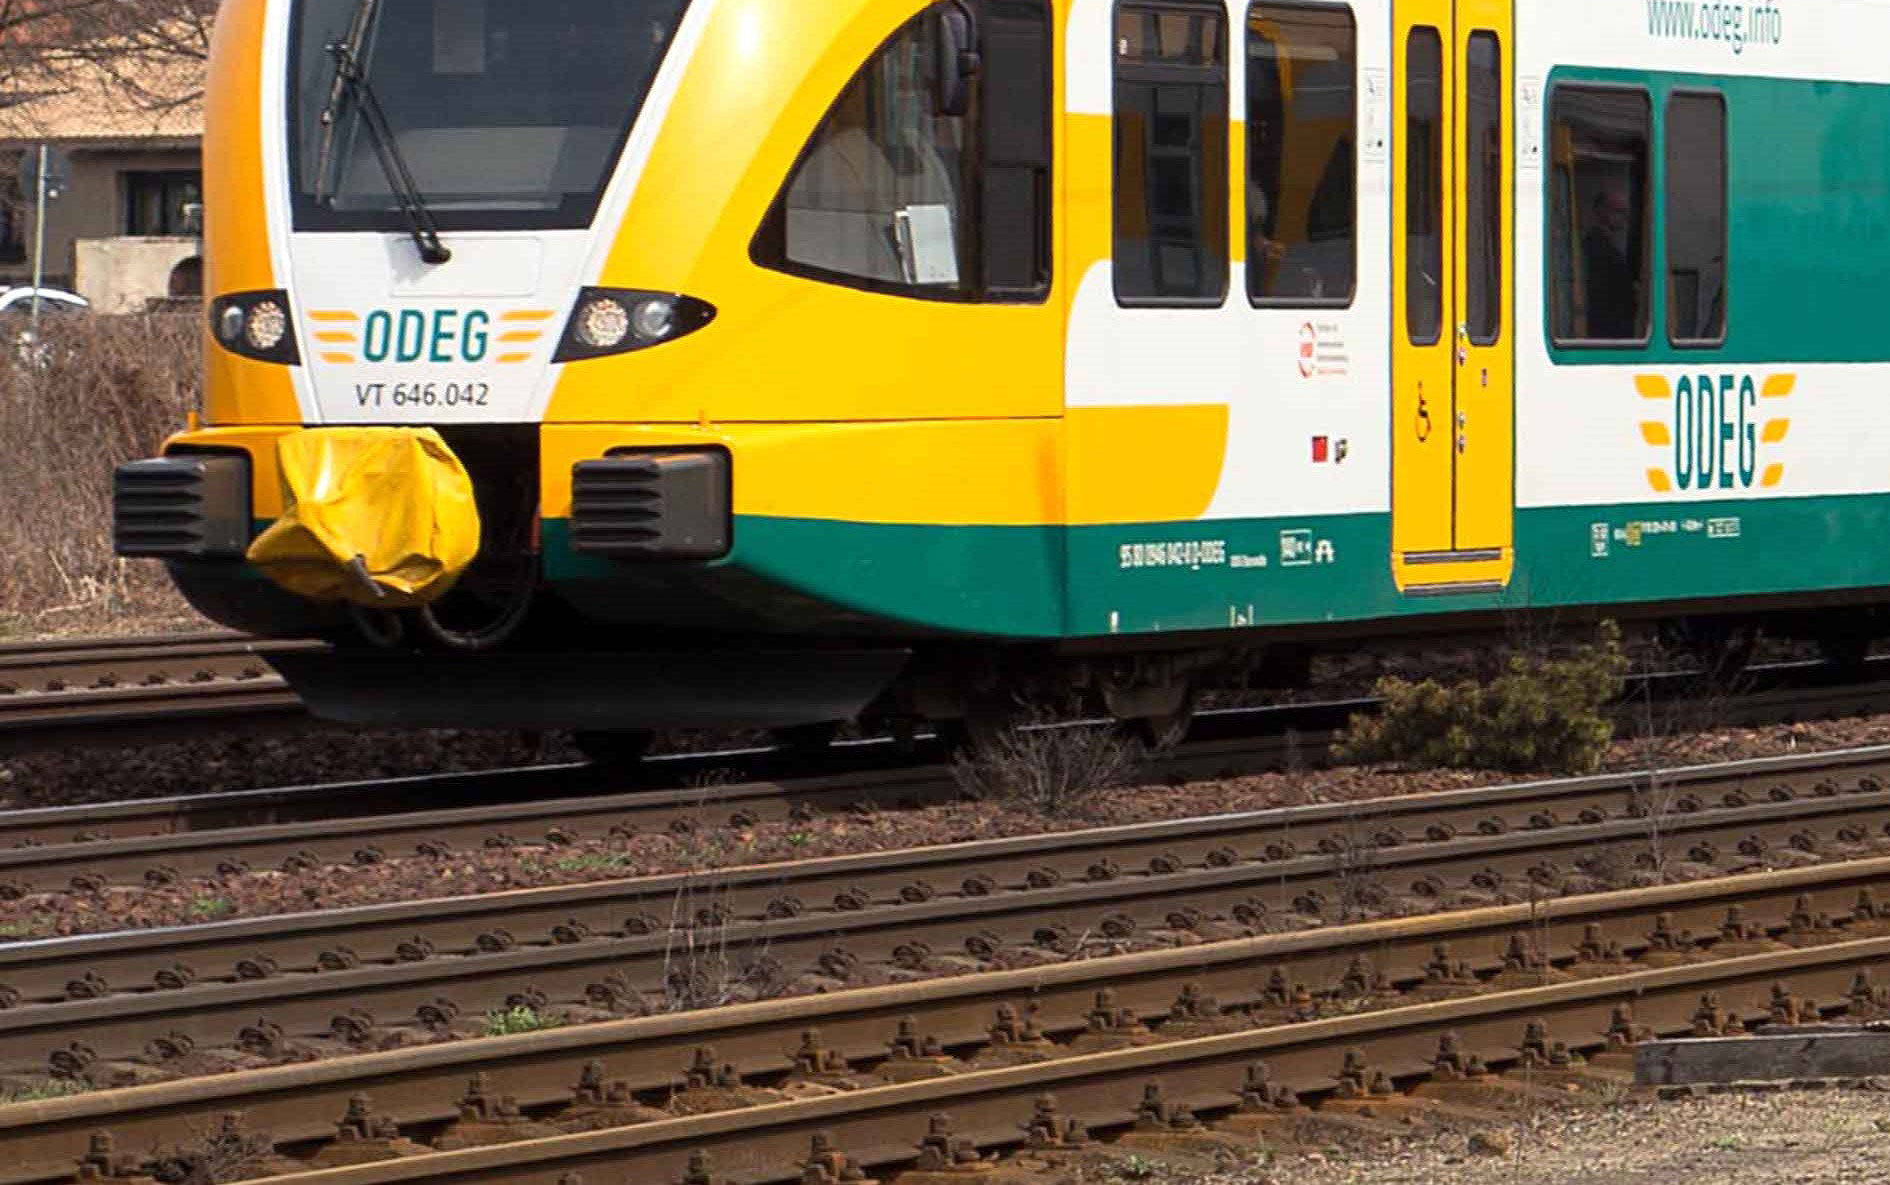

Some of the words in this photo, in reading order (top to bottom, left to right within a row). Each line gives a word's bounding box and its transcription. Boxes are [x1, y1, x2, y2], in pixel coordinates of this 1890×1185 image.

[363, 309, 490, 363] ODEG
[356, 383, 387, 406] VT
[393, 382, 489, 407] 646.042
[1675, 374, 1756, 491] ODEG
